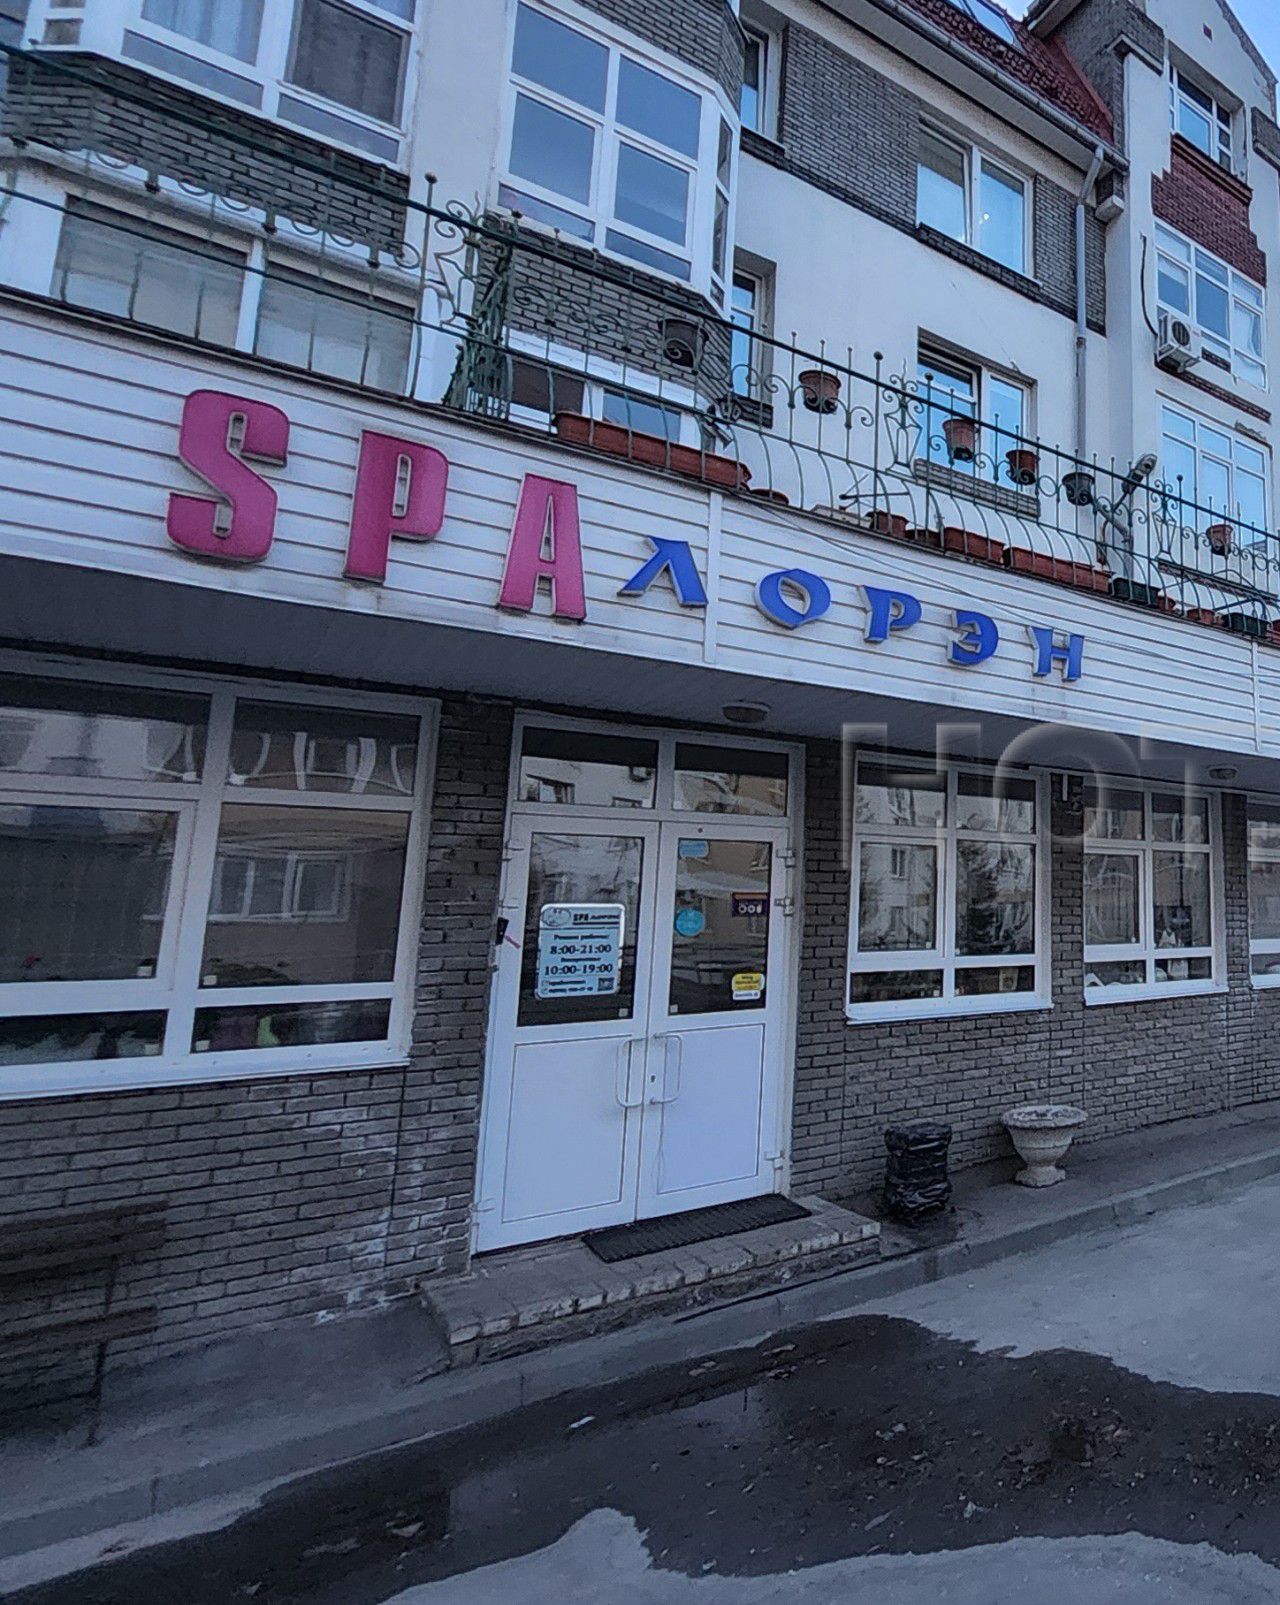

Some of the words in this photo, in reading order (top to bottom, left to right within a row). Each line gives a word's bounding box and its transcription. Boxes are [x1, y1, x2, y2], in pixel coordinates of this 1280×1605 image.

[166, 388, 588, 622] SPA
[618, 535, 1085, 682] ЛОРЭН
[550, 944, 612, 955] 8:00-21:00
[545, 963, 613, 975] 10:00-19:00
